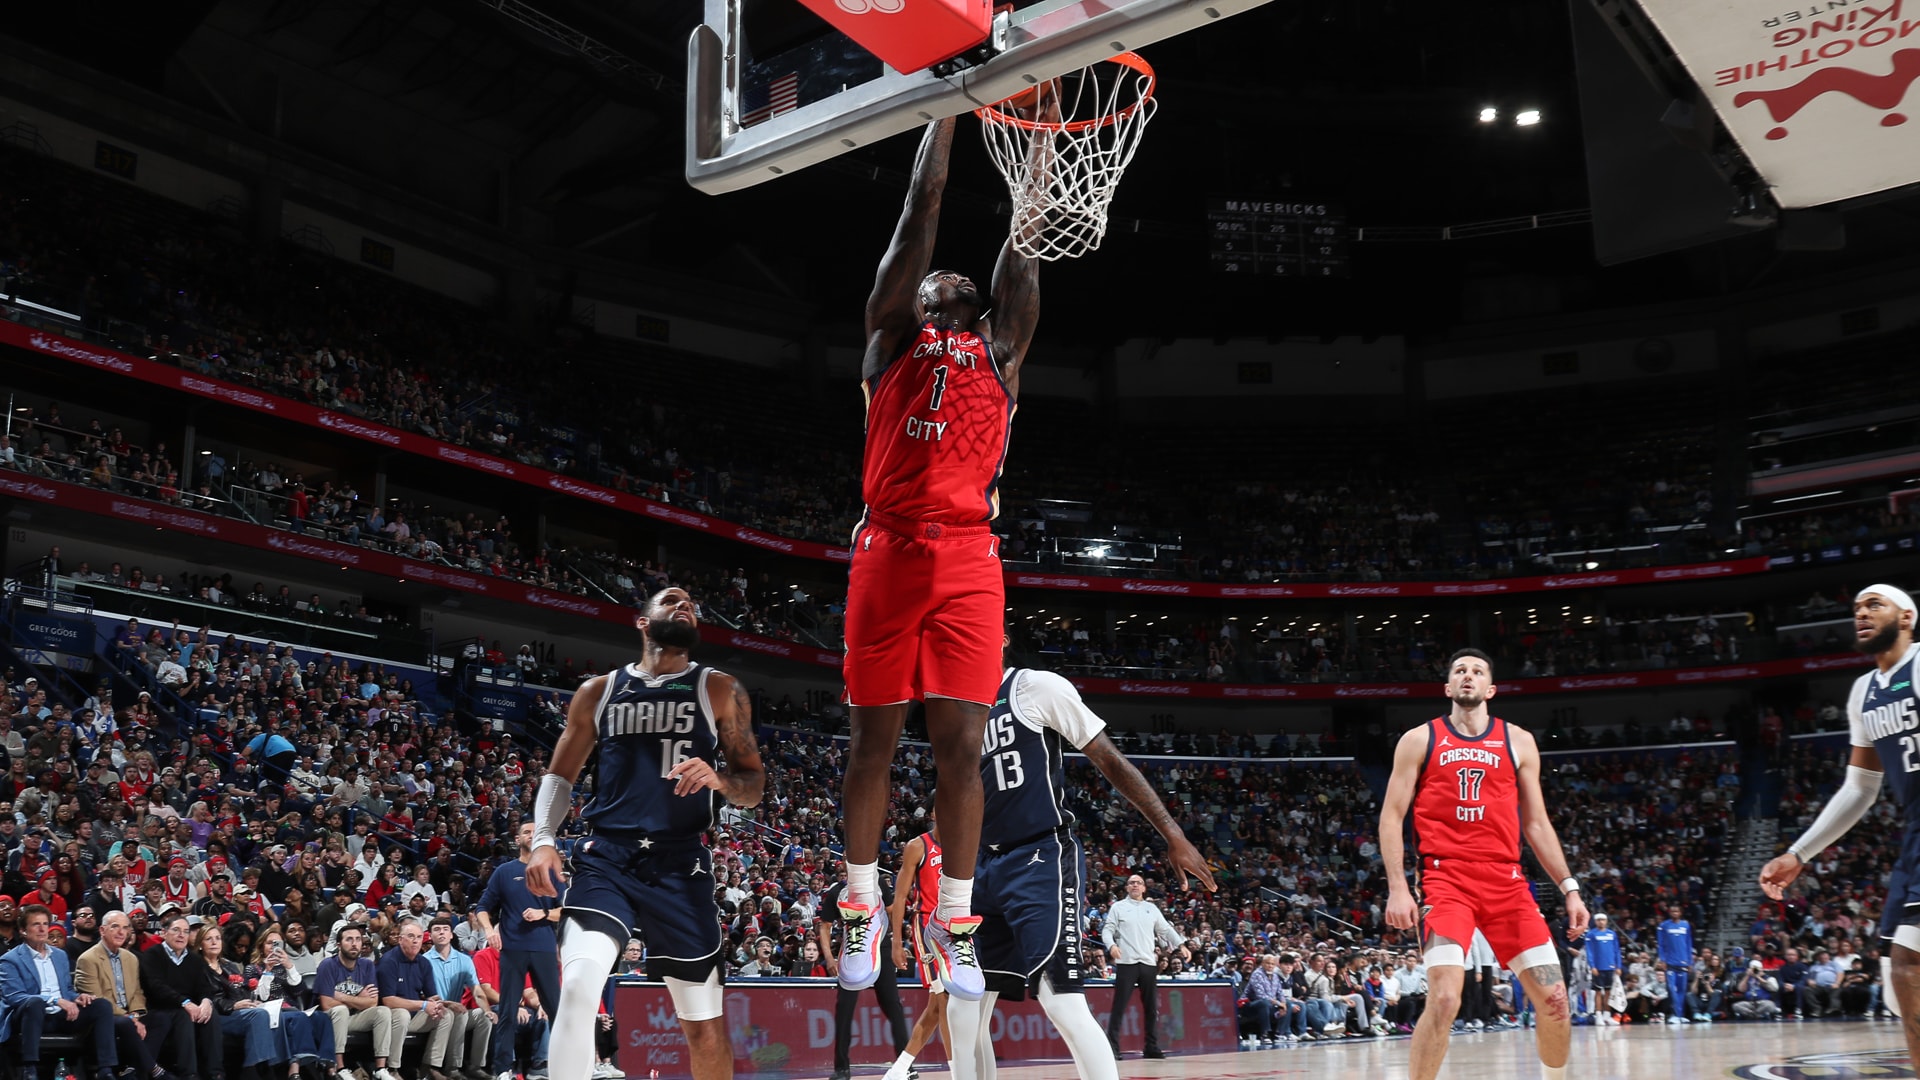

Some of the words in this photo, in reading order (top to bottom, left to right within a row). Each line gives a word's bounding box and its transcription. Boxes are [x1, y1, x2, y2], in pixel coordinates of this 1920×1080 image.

[1762, 0, 1864, 28] NTER
[1713, 20, 1920, 86] MOOTHIE
[99, 147, 134, 171] 317
[1225, 200, 1327, 216] MAVERICKS
[929, 364, 948, 411] 1
[906, 416, 948, 441] CITY
[28, 623, 50, 634] GREY
[50, 627, 80, 639] GOOSE
[530, 639, 557, 664] 114
[607, 701, 696, 737] MAVS
[1151, 714, 1175, 734] 116
[1862, 697, 1920, 741] MAVS
[981, 713, 1016, 756] US
[1439, 748, 1501, 768] CRESCENT
[993, 750, 1025, 792] 13
[1457, 767, 1486, 801] 17
[1456, 805, 1486, 822] CITY
[629, 1029, 688, 1047] SMOOTH
